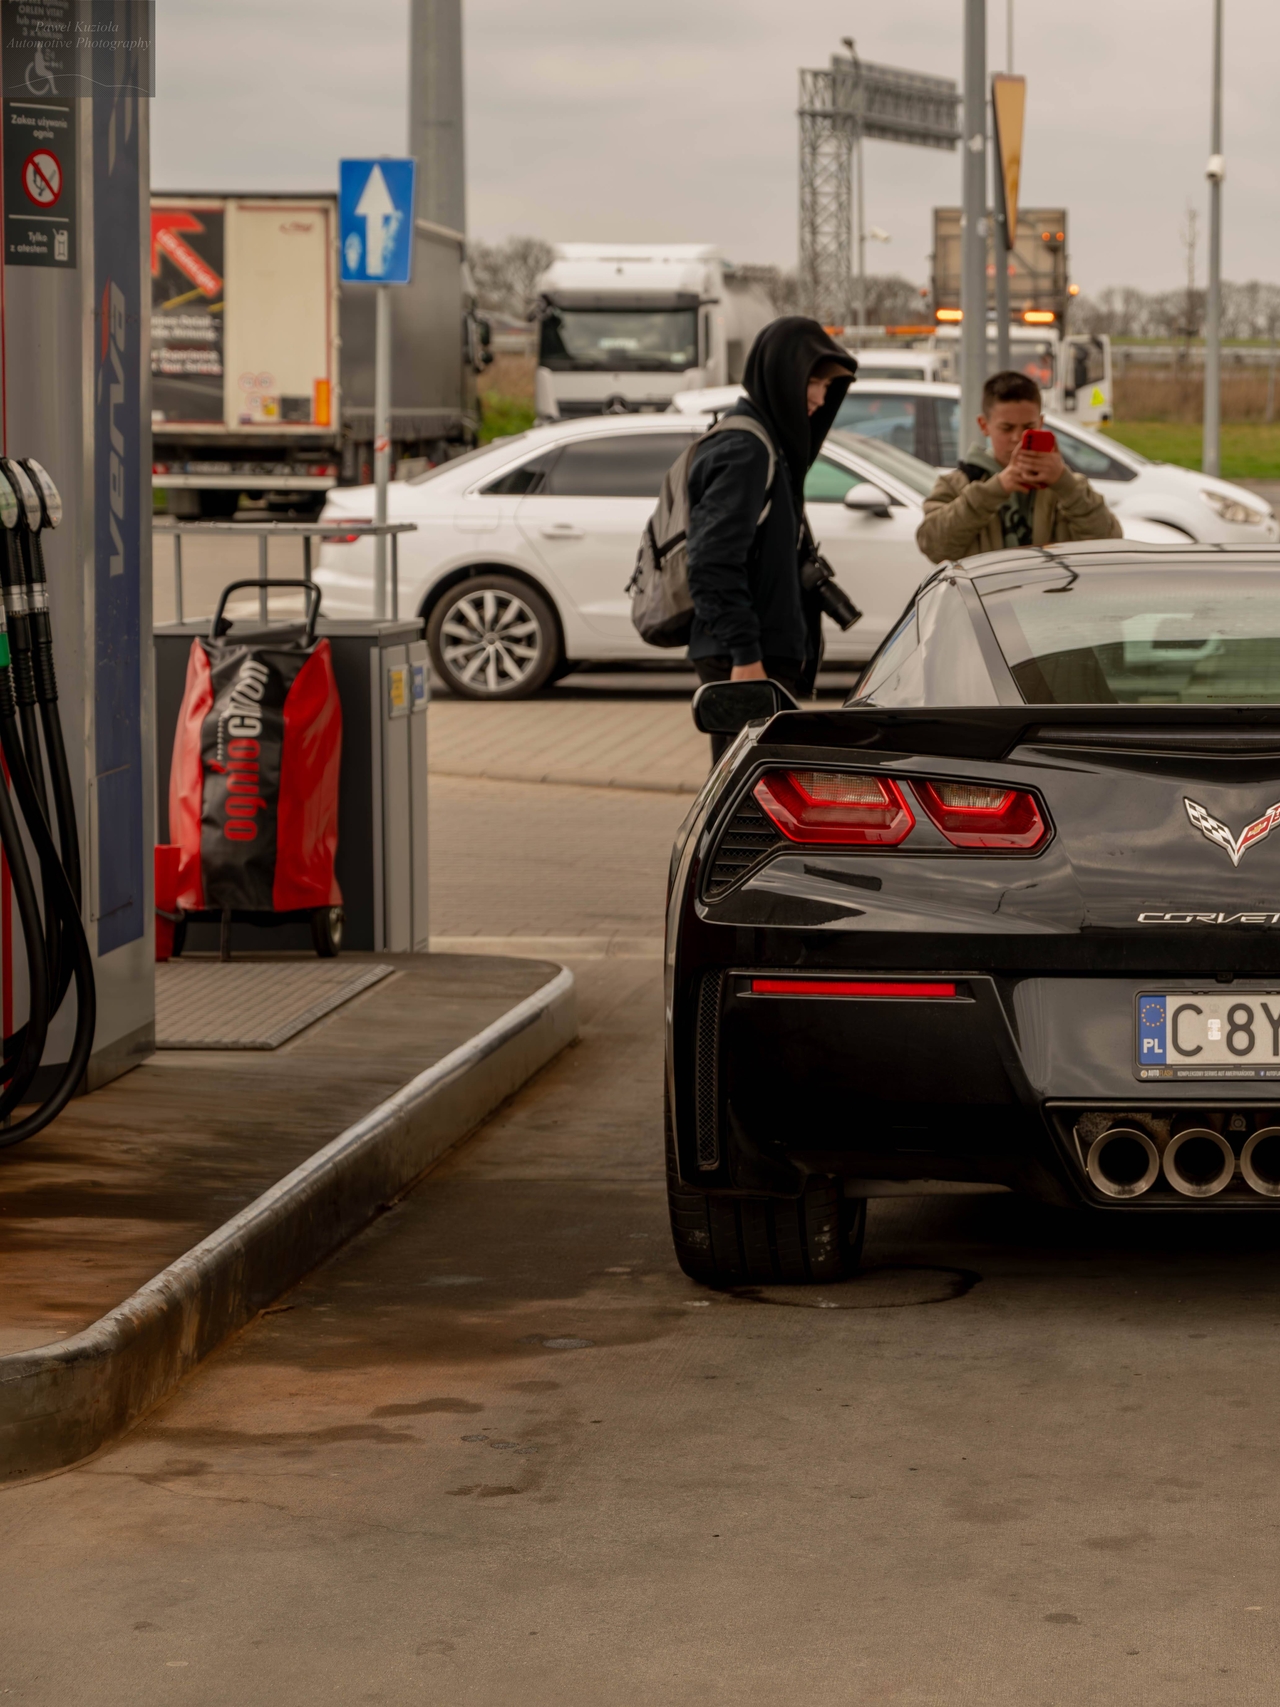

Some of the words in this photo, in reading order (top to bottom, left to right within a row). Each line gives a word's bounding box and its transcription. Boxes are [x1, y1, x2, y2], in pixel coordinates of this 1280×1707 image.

[18, 5, 45, 15] ORLEN
[11, 114, 36, 126] Zakaz
[28, 231, 48, 243] Tylko
[109, 281, 125, 578] verva
[1171, 1003, 1203, 1057] C
[1143, 1038, 1163, 1054] PL
